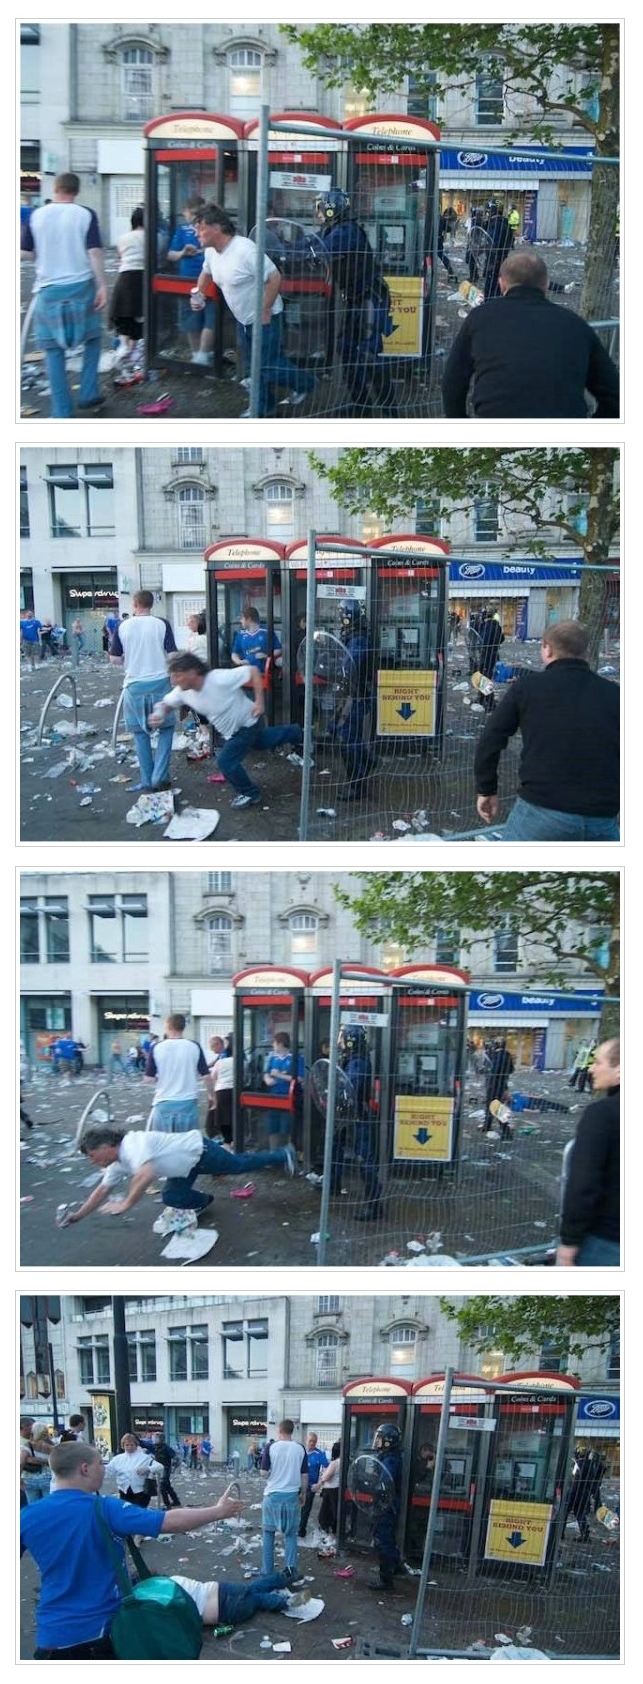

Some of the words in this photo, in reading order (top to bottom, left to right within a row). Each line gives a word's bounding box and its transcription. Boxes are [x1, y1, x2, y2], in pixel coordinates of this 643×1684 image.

[227, 548, 261, 557] Telephone
[503, 566, 536, 575] beauty
[511, 1395, 529, 1403] Coins
